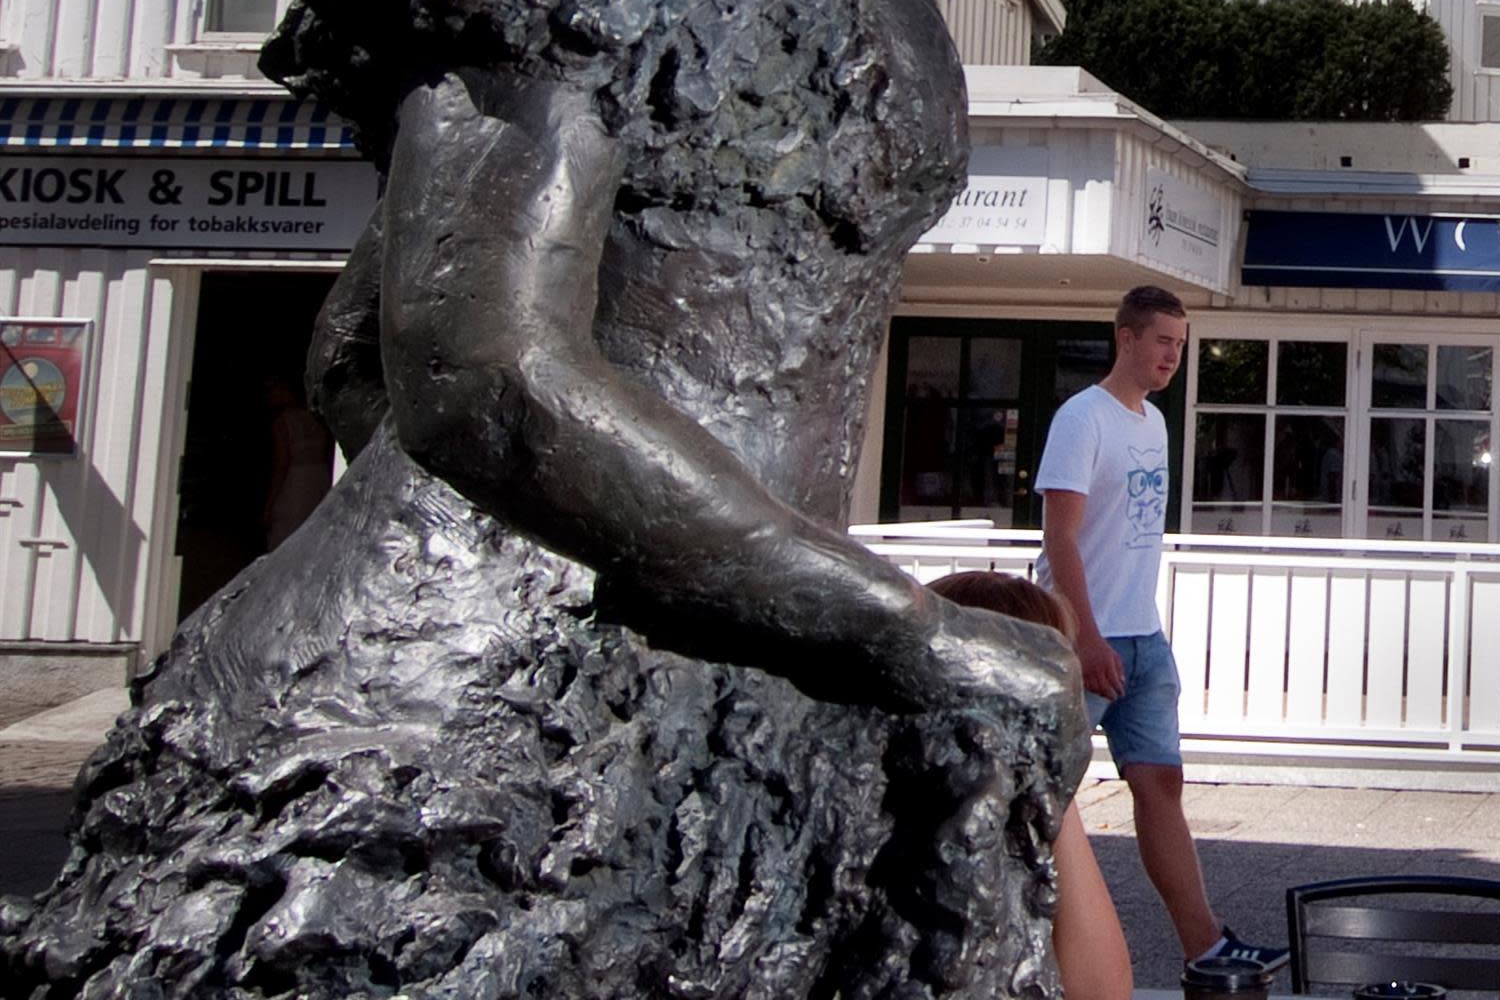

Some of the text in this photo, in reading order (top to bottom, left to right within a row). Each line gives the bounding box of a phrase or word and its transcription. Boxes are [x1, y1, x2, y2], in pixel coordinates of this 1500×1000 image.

[0, 168, 326, 207] KIOSK & SPILL
[150, 214, 179, 232] for
[189, 216, 325, 233] tobakksvarer
